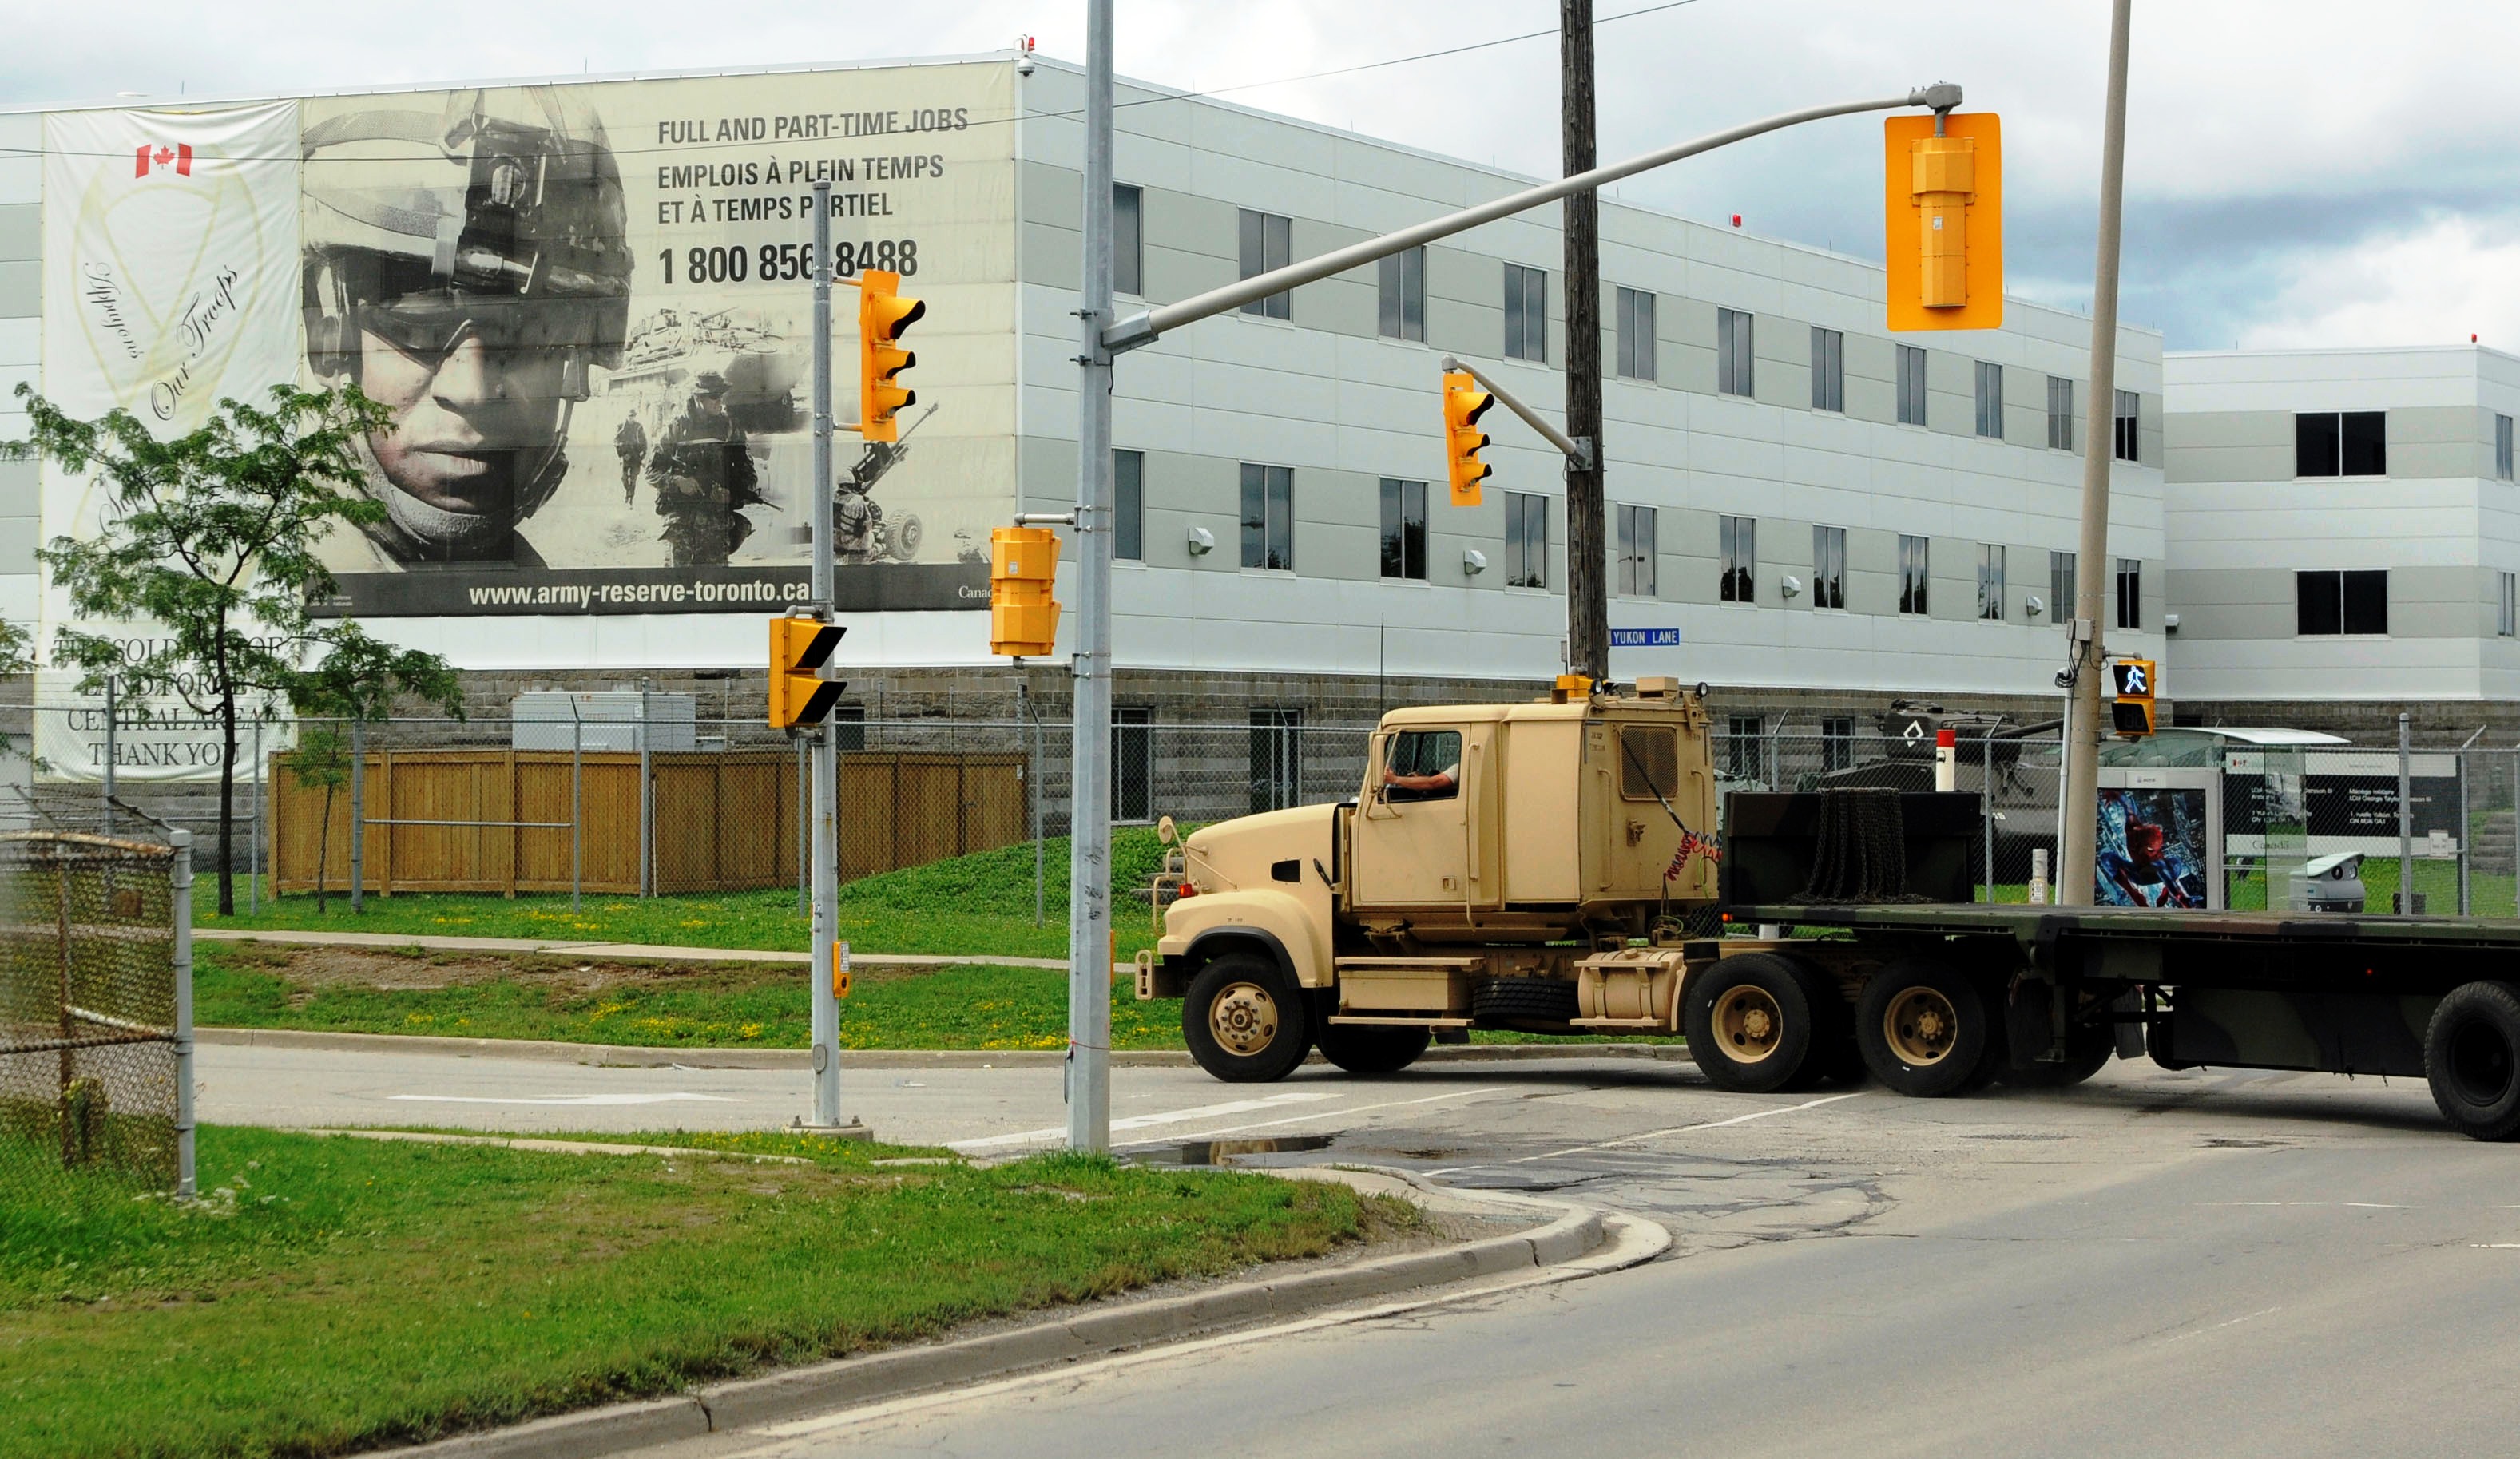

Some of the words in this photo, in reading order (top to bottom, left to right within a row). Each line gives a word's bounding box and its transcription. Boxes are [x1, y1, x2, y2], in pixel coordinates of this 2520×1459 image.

[658, 121, 709, 144] FULL
[716, 117, 767, 141] AND
[774, 111, 898, 139] PART-TIME
[905, 108, 968, 133] JOBS
[658, 162, 758, 188] EMPLOIS
[765, 156, 782, 184] À
[789, 158, 855, 184] PLEIN
[862, 154, 944, 180] TEMPS
[658, 200, 684, 224] ET
[690, 194, 707, 223] À
[712, 196, 792, 222] TEMPS
[800, 192, 893, 219] PRTIEL
[658, 248, 673, 284] 1
[688, 246, 748, 283] 800
[151, 361, 189, 421] Our
[177, 264, 238, 359] Troops
[470, 579, 809, 608] www.army-reserve-toronto.ca
[958, 585, 992, 598] Cana
[1613, 632, 1645, 644] YUKON
[1653, 631, 1677, 644] LANE
[157, 672, 247, 696] FORE
[88, 743, 181, 766] THANK
